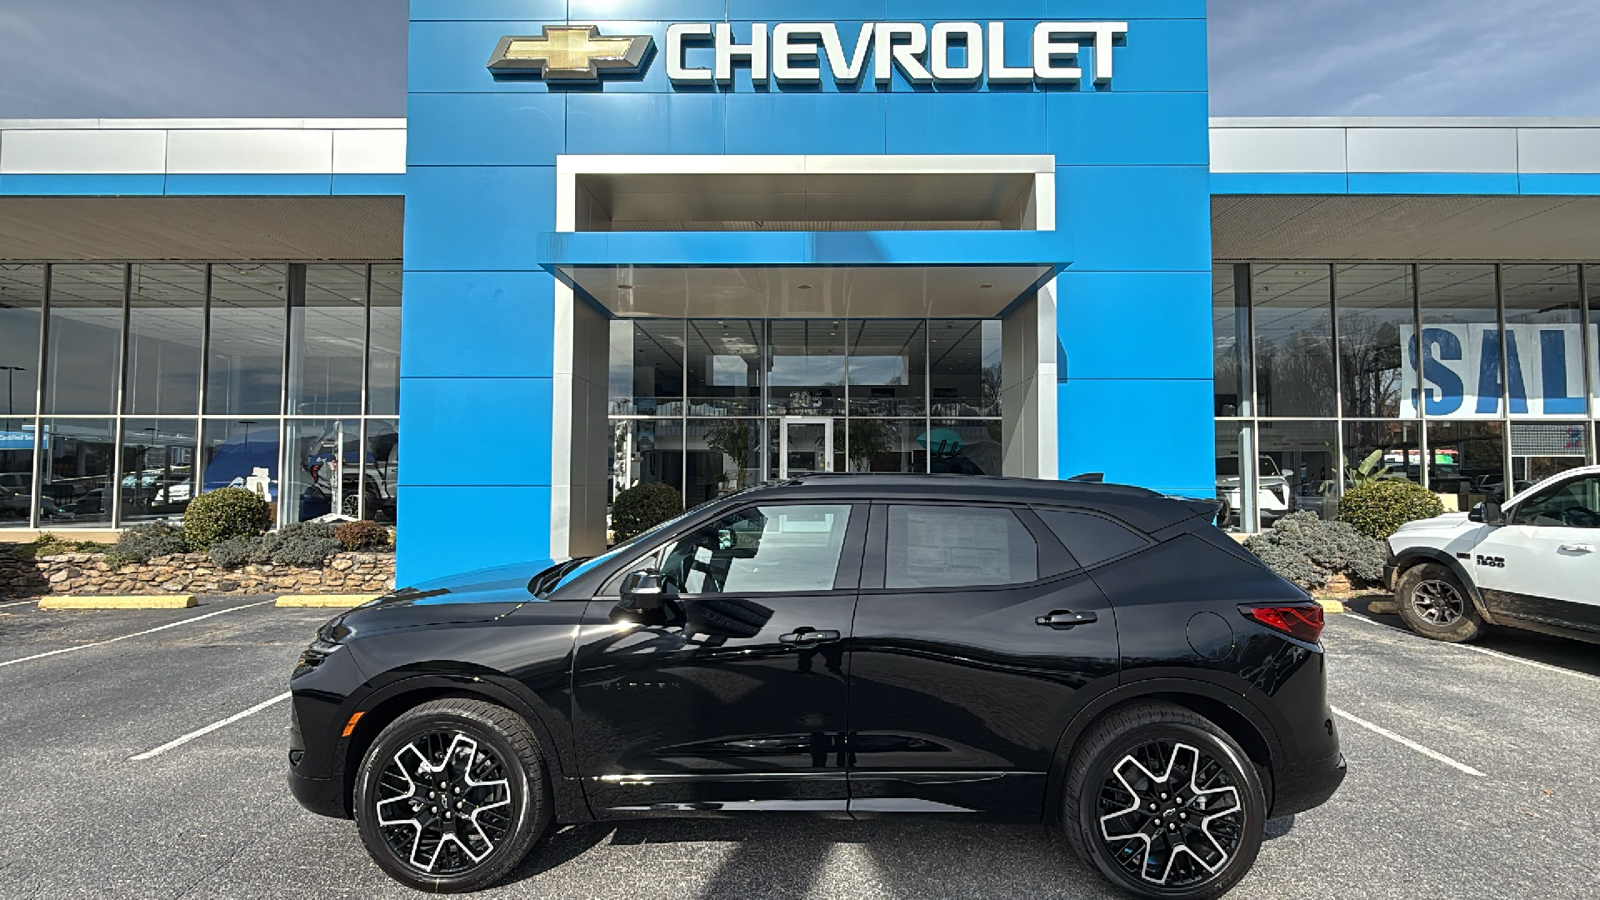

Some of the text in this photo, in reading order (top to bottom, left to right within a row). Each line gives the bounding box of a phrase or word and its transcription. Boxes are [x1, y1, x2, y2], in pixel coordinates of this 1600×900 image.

[666, 22, 1128, 86] CHEVROLET
[1476, 554, 1505, 563] RAM
[1476, 559, 1505, 568] 1500
